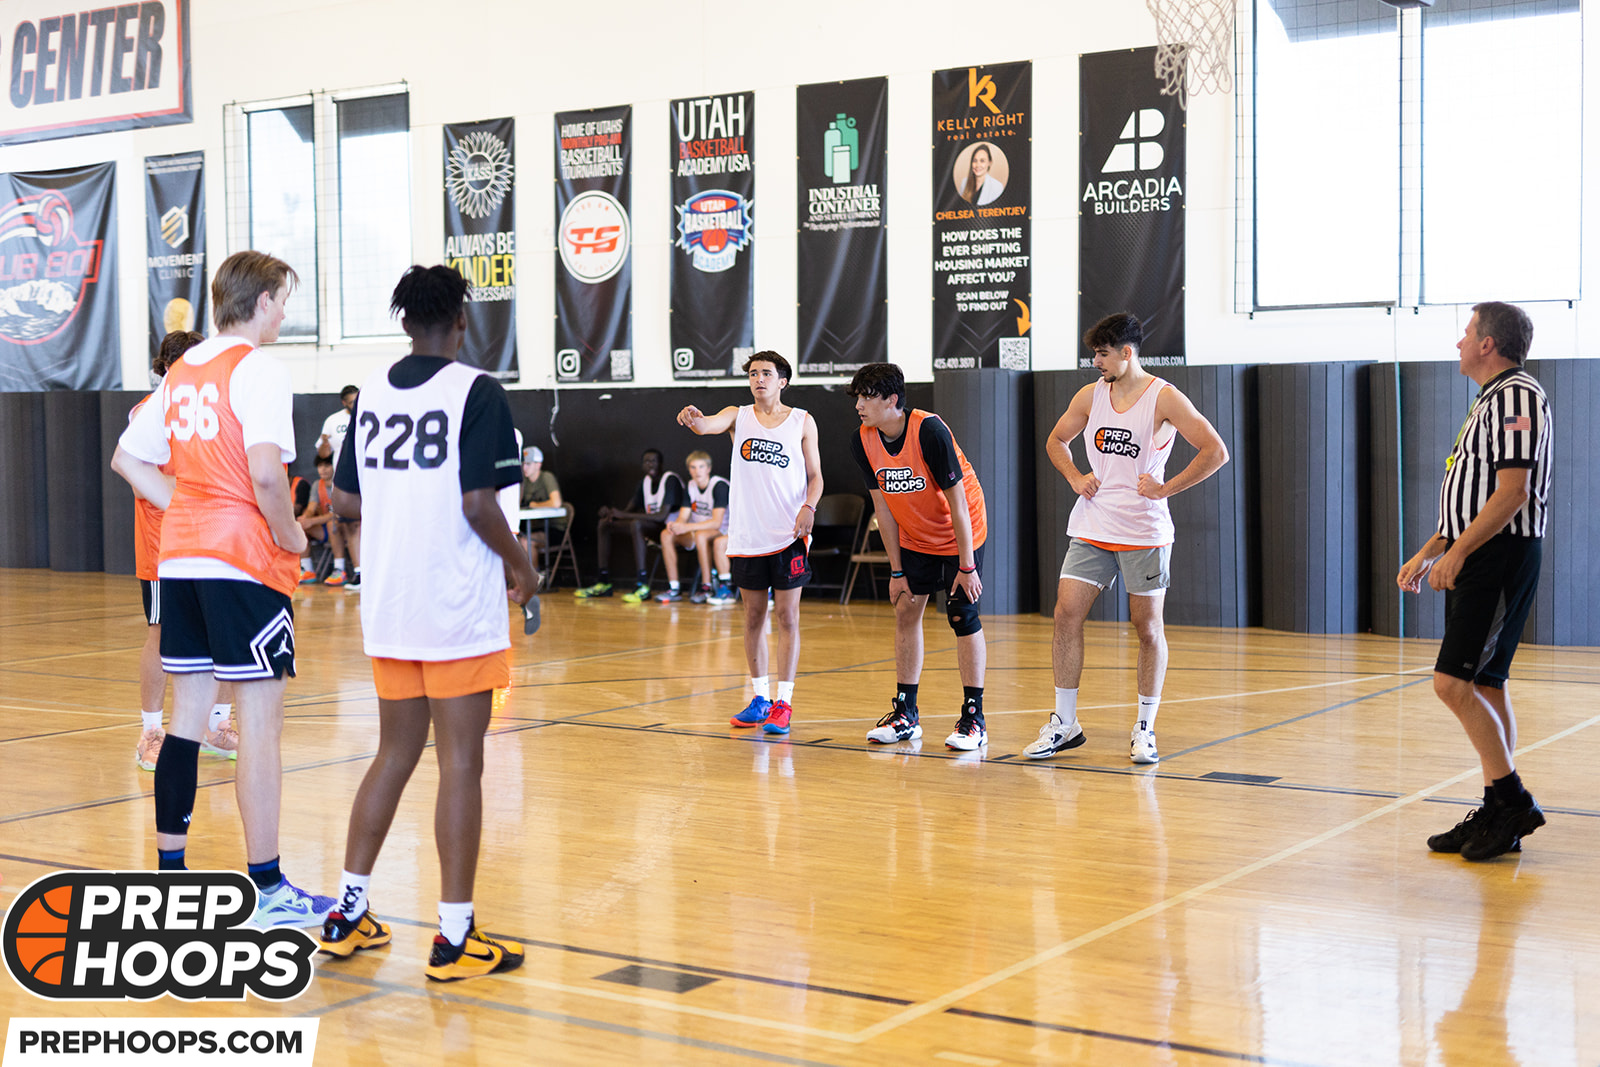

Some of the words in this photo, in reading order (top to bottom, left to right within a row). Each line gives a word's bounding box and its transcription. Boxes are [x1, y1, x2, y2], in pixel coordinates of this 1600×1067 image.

[9, 0, 166, 109] CENTER
[678, 95, 745, 142] UTAH
[937, 117, 979, 132] KELLY
[983, 113, 1025, 128] RIGHT
[561, 123, 586, 138] HOME
[585, 121, 596, 136] OF
[596, 119, 624, 135] UTAHS
[947, 131, 970, 141] real
[561, 144, 623, 166] BASKETBALL
[679, 136, 748, 160] BASKETBALL
[561, 161, 624, 180] TOURNAMENTS
[677, 156, 727, 177] ACADEMY
[727, 153, 751, 173] USA
[808, 184, 881, 202] INDUSTRIAL
[1083, 176, 1183, 202] ARCADIA
[700, 199, 727, 213] UTAH
[809, 197, 881, 215] CONTAINER
[935, 209, 975, 220] CHELSEA
[977, 206, 1027, 218] TERENTJEV
[1094, 197, 1171, 215] BUILDERS
[684, 208, 744, 235] BASKETBALL
[941, 230, 969, 243] HOW
[969, 229, 999, 241] DOES
[1000, 227, 1023, 239] THE
[446, 232, 496, 258] ALWAYS
[496, 231, 515, 255] BE
[942, 245, 970, 257] EVER
[971, 242, 1021, 255] SHIFTING
[148, 253, 205, 268] MOVEMENT
[934, 258, 984, 271] HOUSING
[984, 255, 1030, 269] MARKET
[159, 267, 195, 280] CLINIC
[946, 272, 986, 285] AFFECT
[987, 271, 1017, 283] YOU?
[955, 291, 978, 301] SCAN
[978, 289, 1010, 301] BELOW
[956, 303, 969, 312] TO
[968, 302, 990, 312] FIND
[990, 301, 1009, 311] OUT
[359, 409, 449, 470] 228
[1104, 429, 1131, 441] PREP
[751, 440, 781, 453] PREP
[750, 450, 789, 467] HOOPS
[886, 469, 911, 481] PREP
[886, 478, 924, 492] HOOPS
